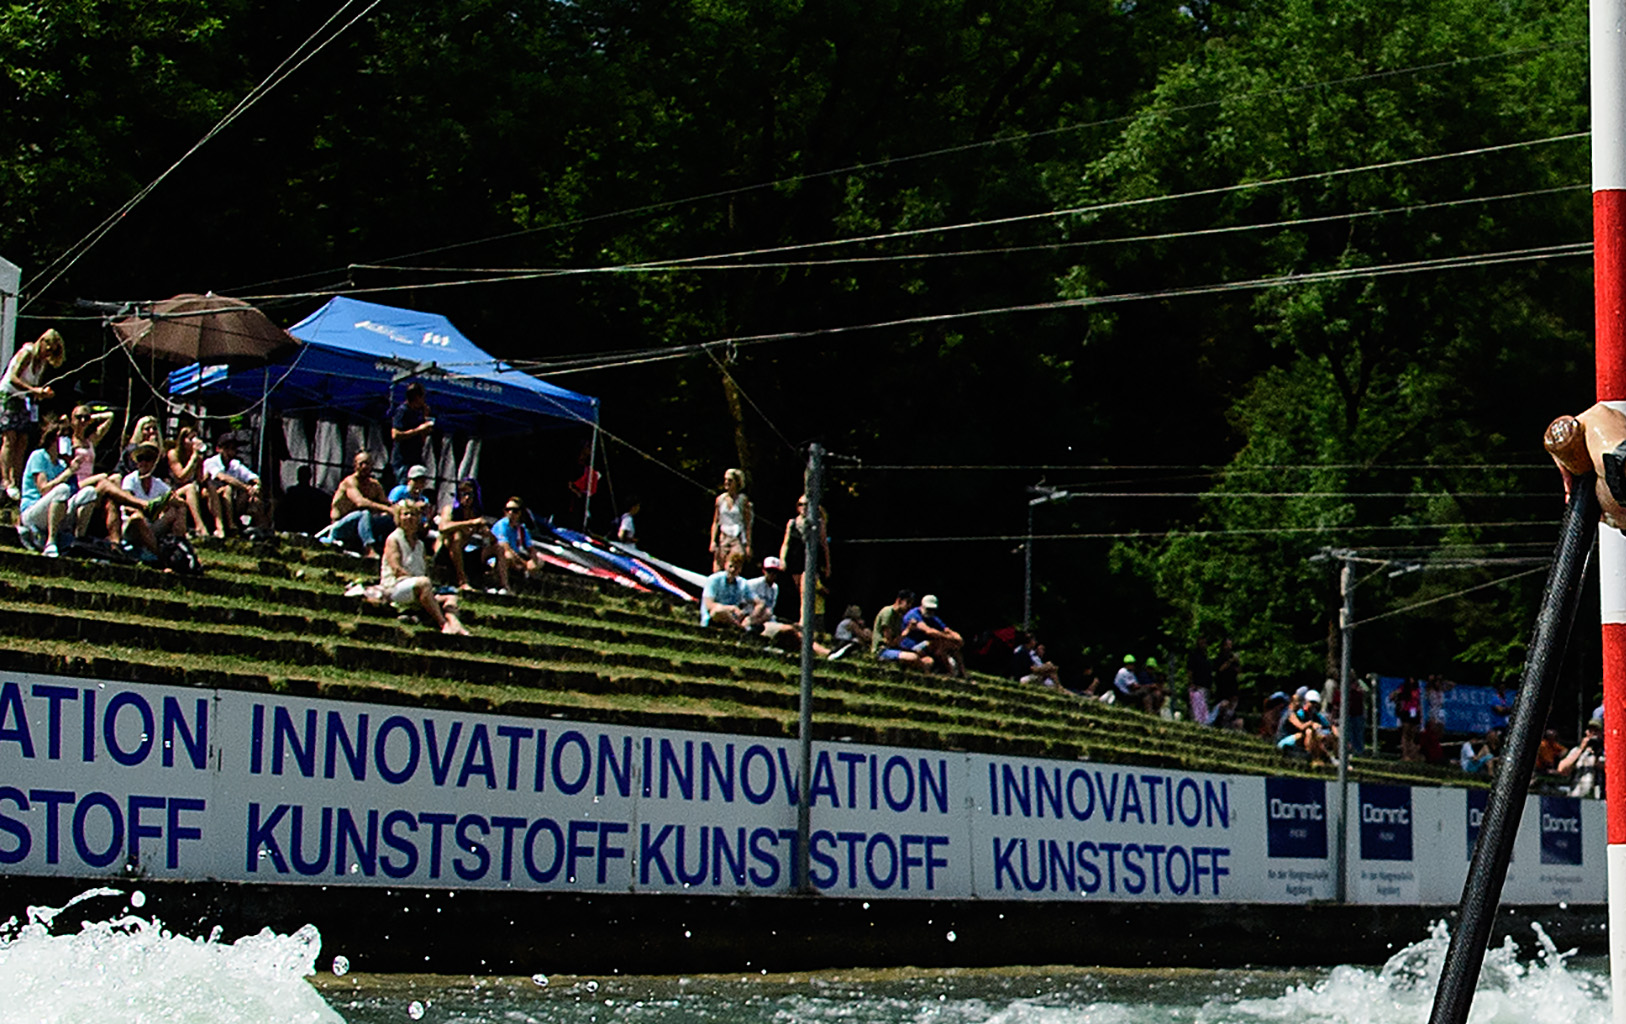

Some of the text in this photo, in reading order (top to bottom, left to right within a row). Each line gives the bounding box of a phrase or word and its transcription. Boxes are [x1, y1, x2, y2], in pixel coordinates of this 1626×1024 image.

[0, 682, 208, 770] ATION
[250, 703, 633, 797] INNOVATION
[642, 737, 948, 814] INNOVATION
[989, 762, 1230, 829] INNOVATION
[0, 786, 205, 869] STOFF
[246, 803, 628, 883] KUNSTSTOFF
[640, 823, 949, 890] KUNSTSTOFF
[992, 838, 1231, 895] KUNSTSTOFF
